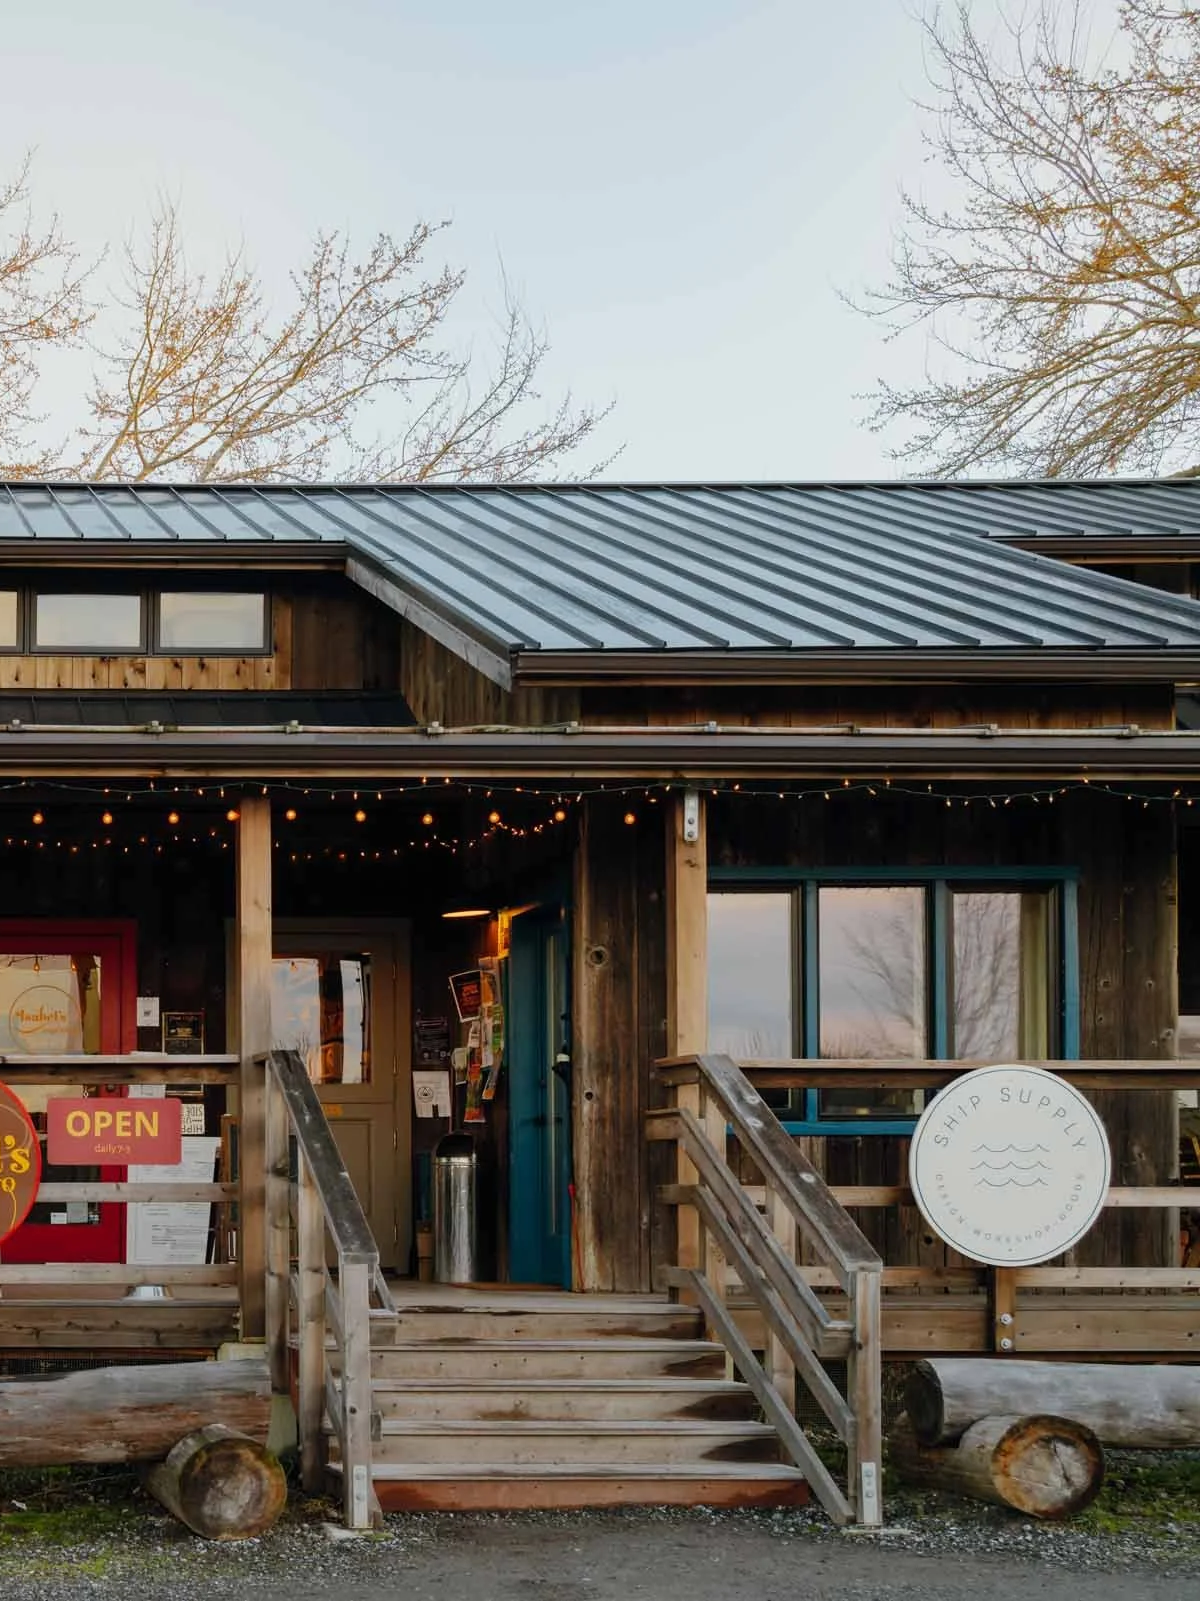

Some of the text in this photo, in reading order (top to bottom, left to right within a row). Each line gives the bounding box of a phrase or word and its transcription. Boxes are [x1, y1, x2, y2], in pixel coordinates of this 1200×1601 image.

[65, 1110, 159, 1137] OPEN
[934, 1087, 1087, 1148] SHIP SUPPLY
[94, 1143, 116, 1154] daily
